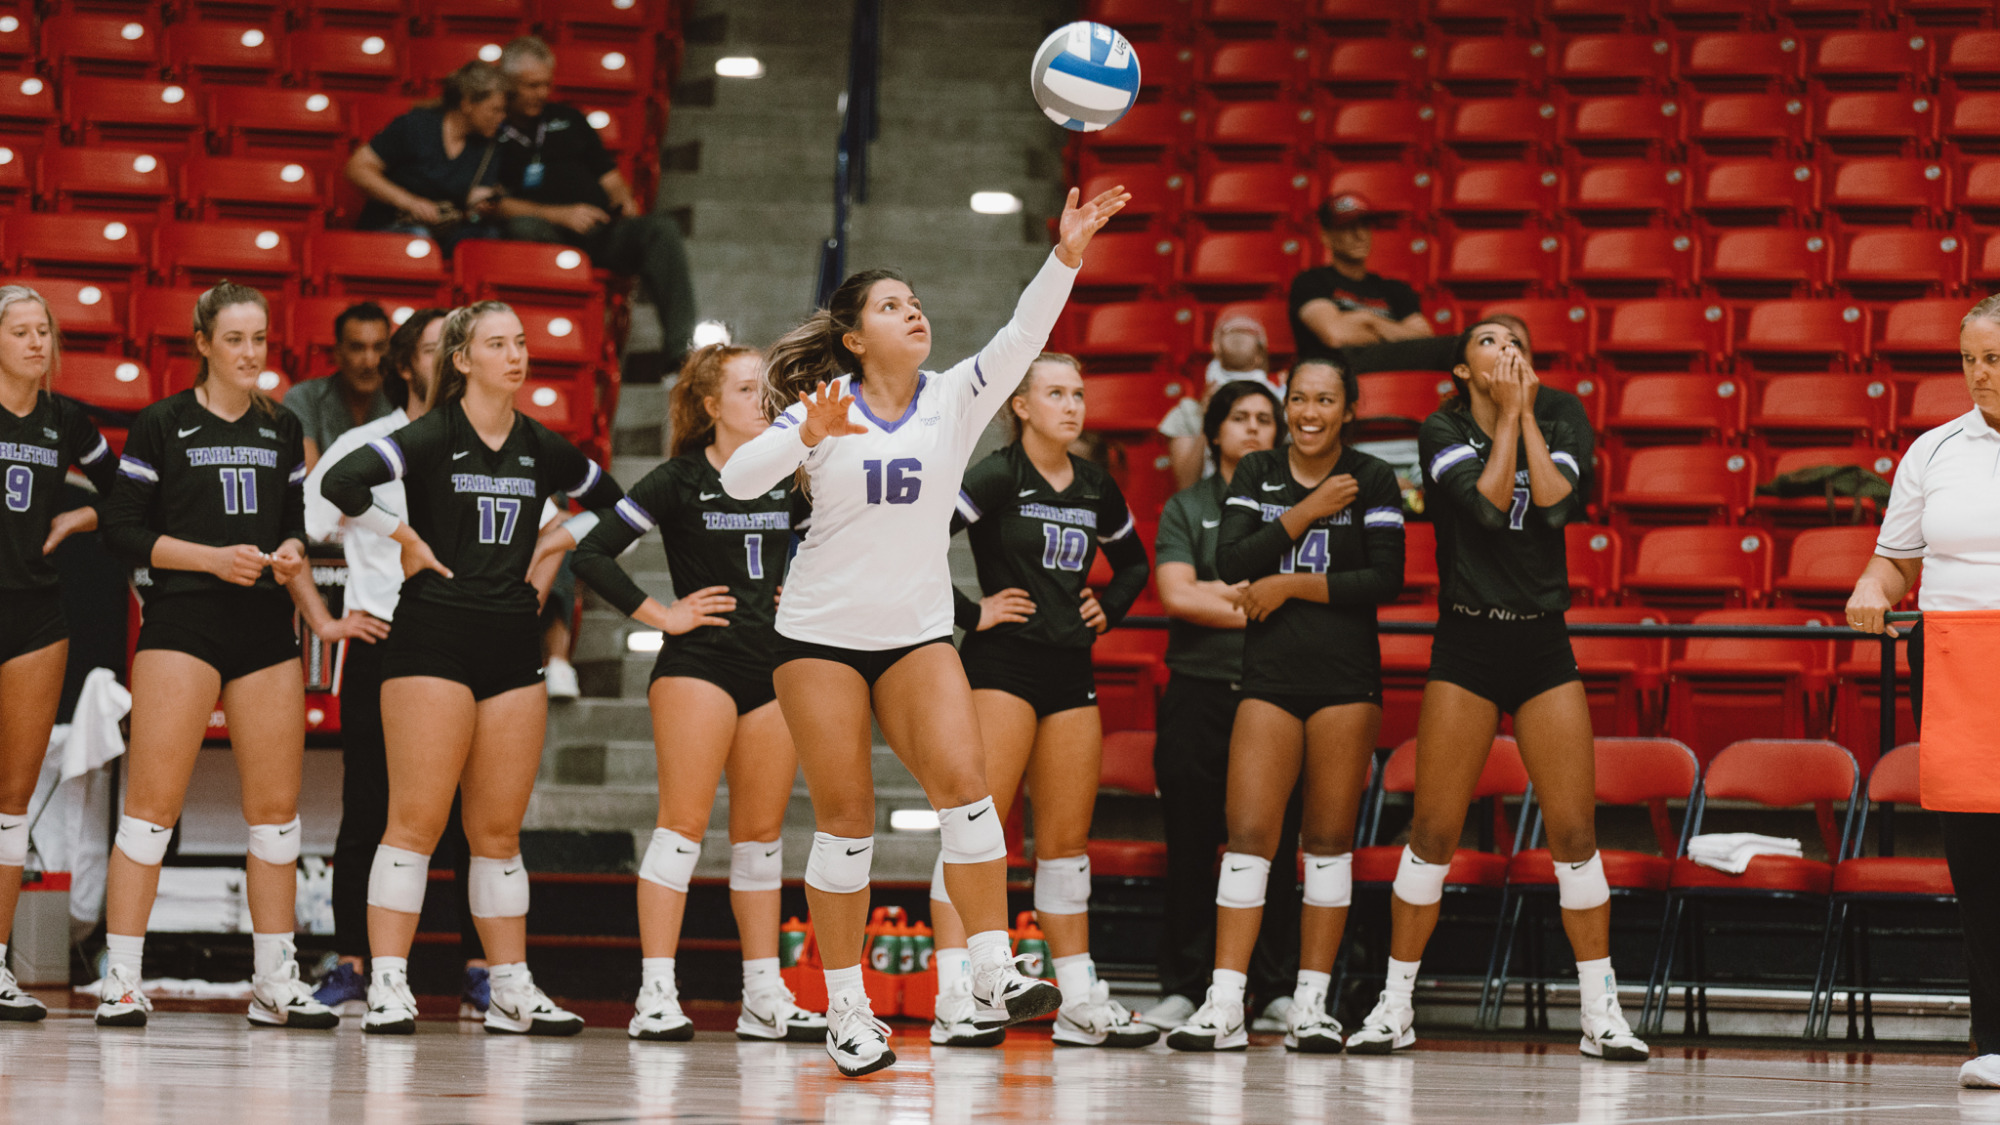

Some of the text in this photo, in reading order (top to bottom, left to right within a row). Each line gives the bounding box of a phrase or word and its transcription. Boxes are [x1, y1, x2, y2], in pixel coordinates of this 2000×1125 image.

[186, 446, 278, 468] TARLETON
[5, 464, 34, 512] 9
[219, 468, 258, 514] 11
[451, 473, 536, 498] TARLETON
[863, 457, 922, 505] 16
[477, 497, 521, 545] 17
[702, 511, 790, 530] TARLETON
[1018, 502, 1097, 529] TARLETON
[1509, 487, 1530, 530] 7
[744, 533, 764, 579] 1
[1042, 522, 1088, 572] 10
[1279, 528, 1331, 574] 14
